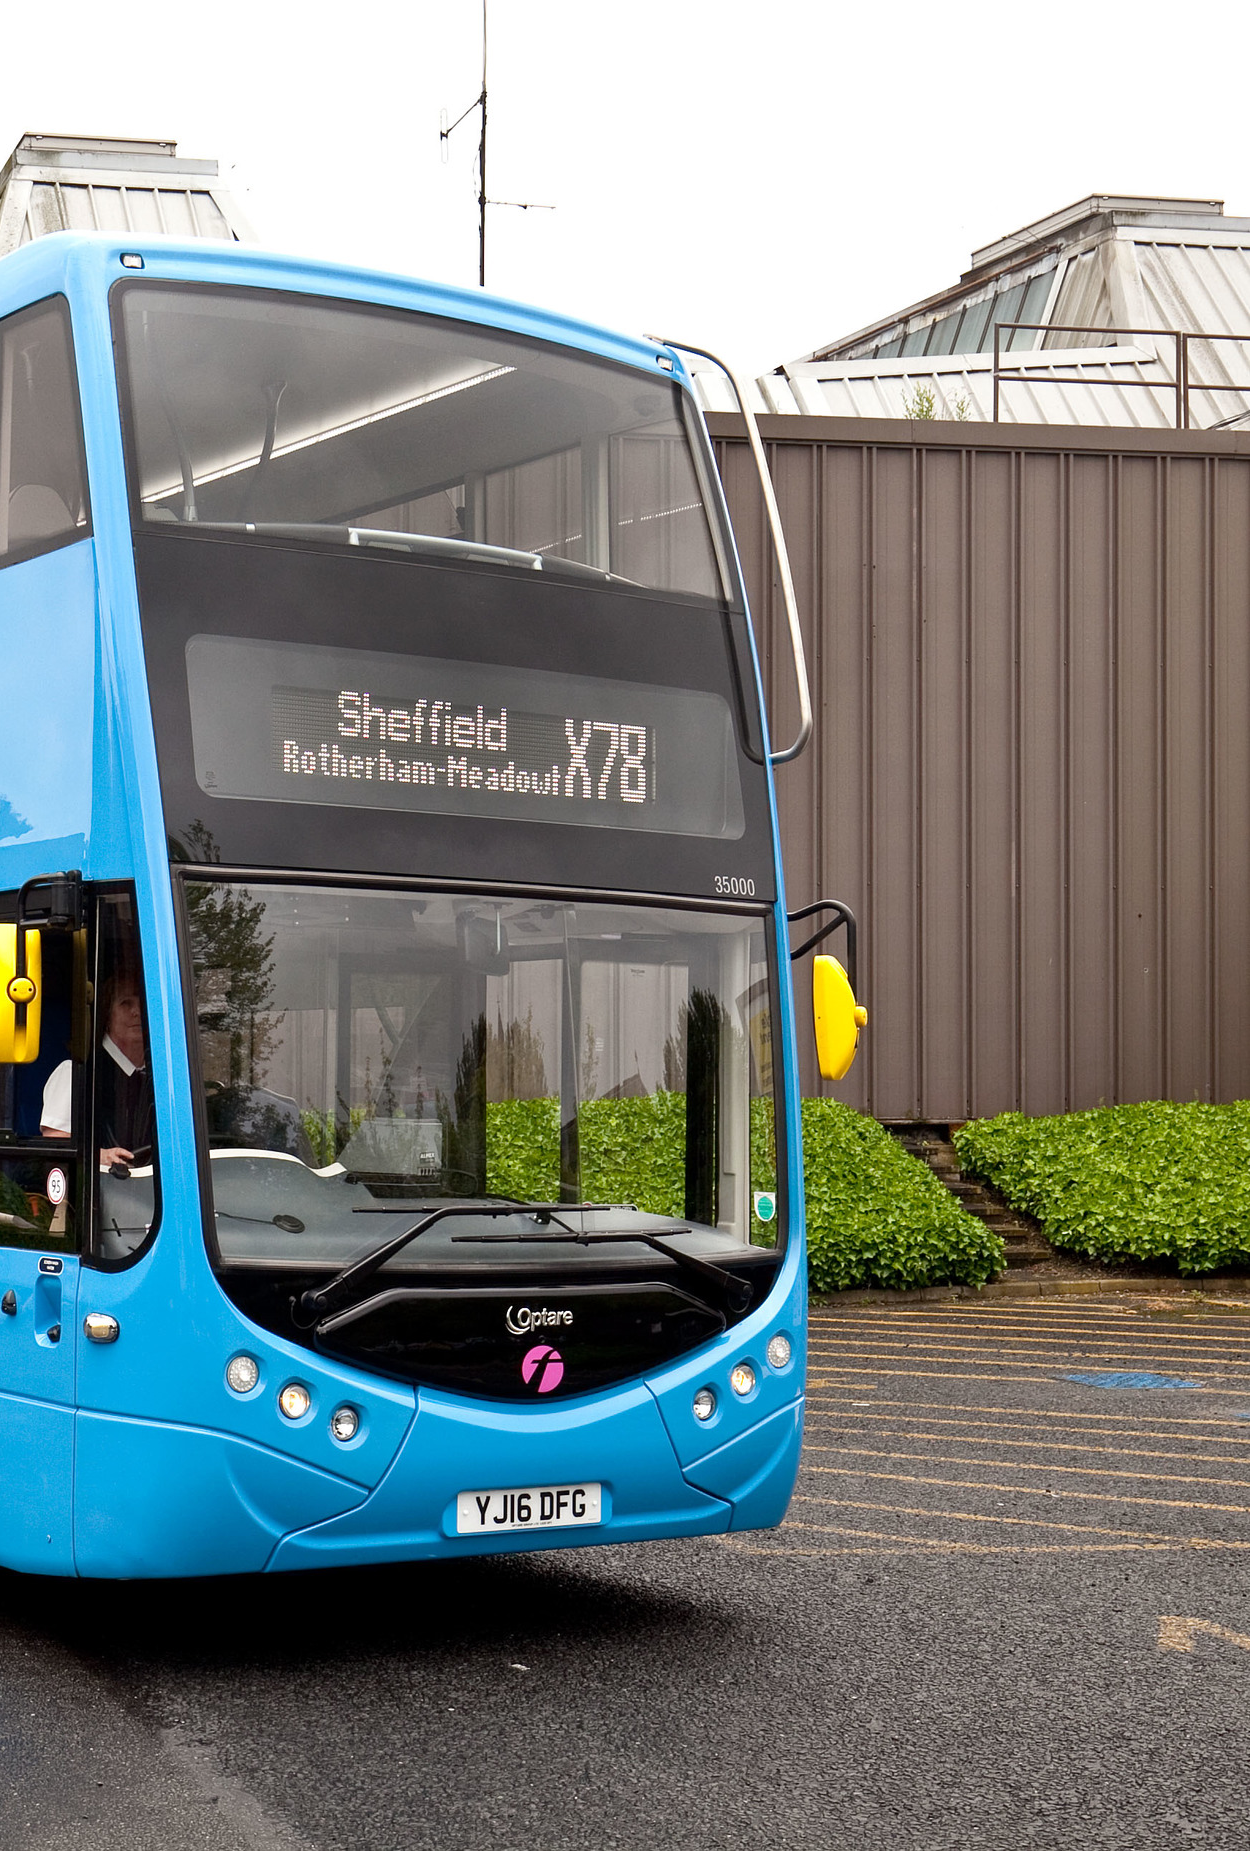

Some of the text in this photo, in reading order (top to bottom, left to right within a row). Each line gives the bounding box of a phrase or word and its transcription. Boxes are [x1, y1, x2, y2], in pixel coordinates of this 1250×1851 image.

[338, 690, 507, 751] Sheffield
[565, 718, 646, 803] X78
[714, 875, 755, 896] 35000
[51, 1179, 61, 1194] 95
[516, 1307, 574, 1332] Optare
[475, 1488, 586, 1526] YJ16 DFG
